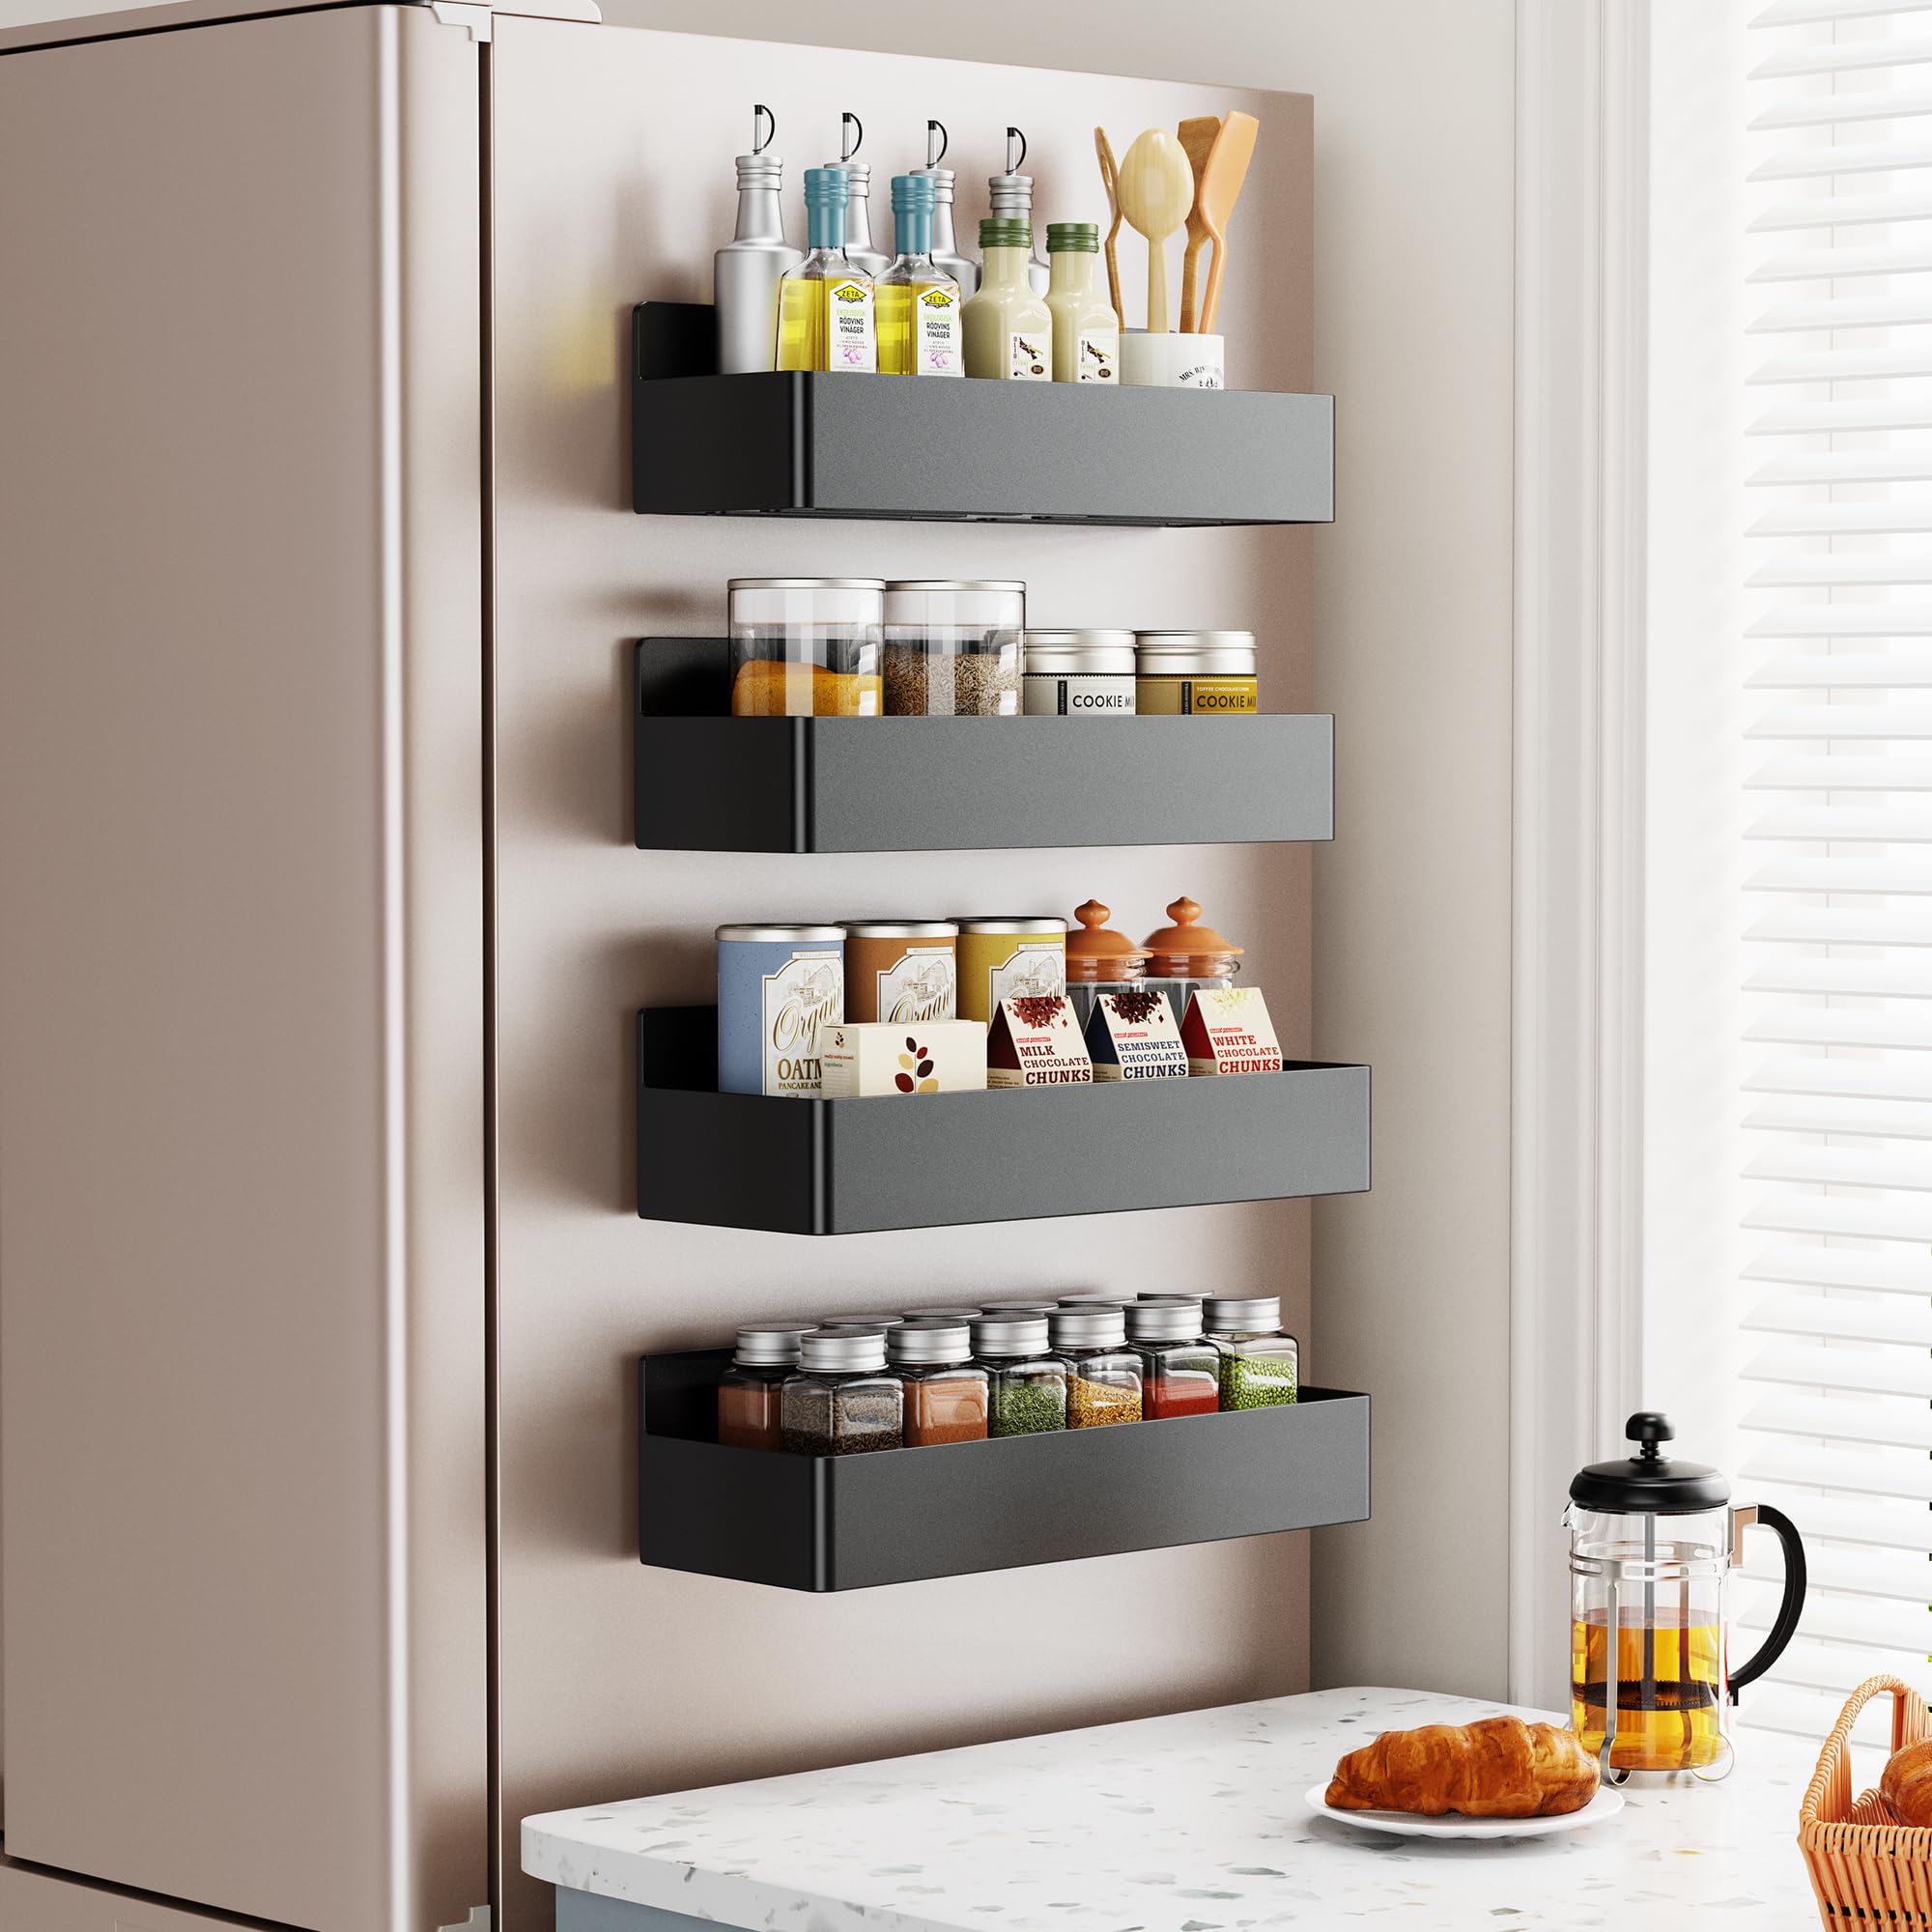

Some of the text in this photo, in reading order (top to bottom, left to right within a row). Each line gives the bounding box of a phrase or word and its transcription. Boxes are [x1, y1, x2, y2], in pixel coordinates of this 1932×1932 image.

[838, 316, 865, 326] RÖDVINS
[926, 321, 951, 330] RÖDVINS
[839, 324, 865, 333] VINÄGER
[926, 328, 951, 338] VINÄGER
[1072, 695, 1122, 708] COOKIE
[1196, 695, 1245, 707] COOKIE
[1118, 1040, 1180, 1052] SEMISWEET
[1213, 1035, 1257, 1046] WHITE
[1019, 1045, 1055, 1057] MILK
[1122, 1051, 1185, 1063] CHOCOLATE
[1217, 1046, 1279, 1058] CHOCOLATE
[1024, 1057, 1090, 1068] CHOCOLATE
[1219, 1059, 1280, 1074] CHUNKS
[1026, 1068, 1091, 1085] CHUNKS
[1123, 1064, 1186, 1079] CHUNKS
